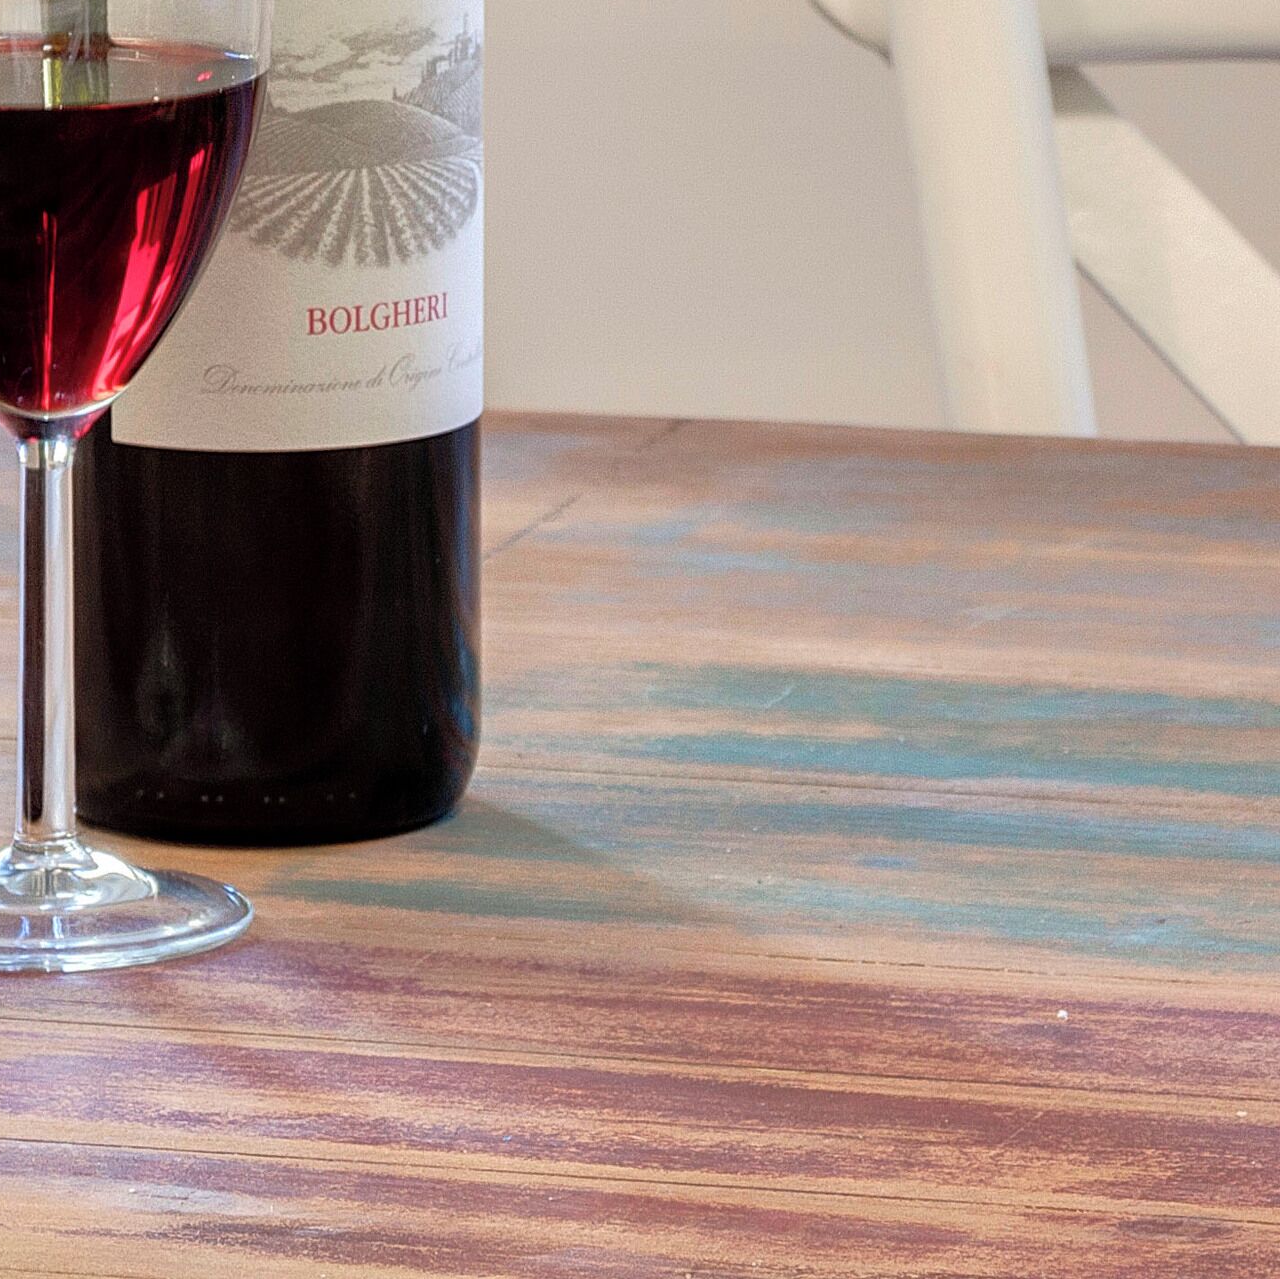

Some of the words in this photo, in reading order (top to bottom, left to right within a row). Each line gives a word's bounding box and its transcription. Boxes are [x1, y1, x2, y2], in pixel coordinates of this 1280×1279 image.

[306, 292, 448, 336] BOLGHERI
[201, 363, 363, 395] Denominazione
[365, 364, 386, 389] di
